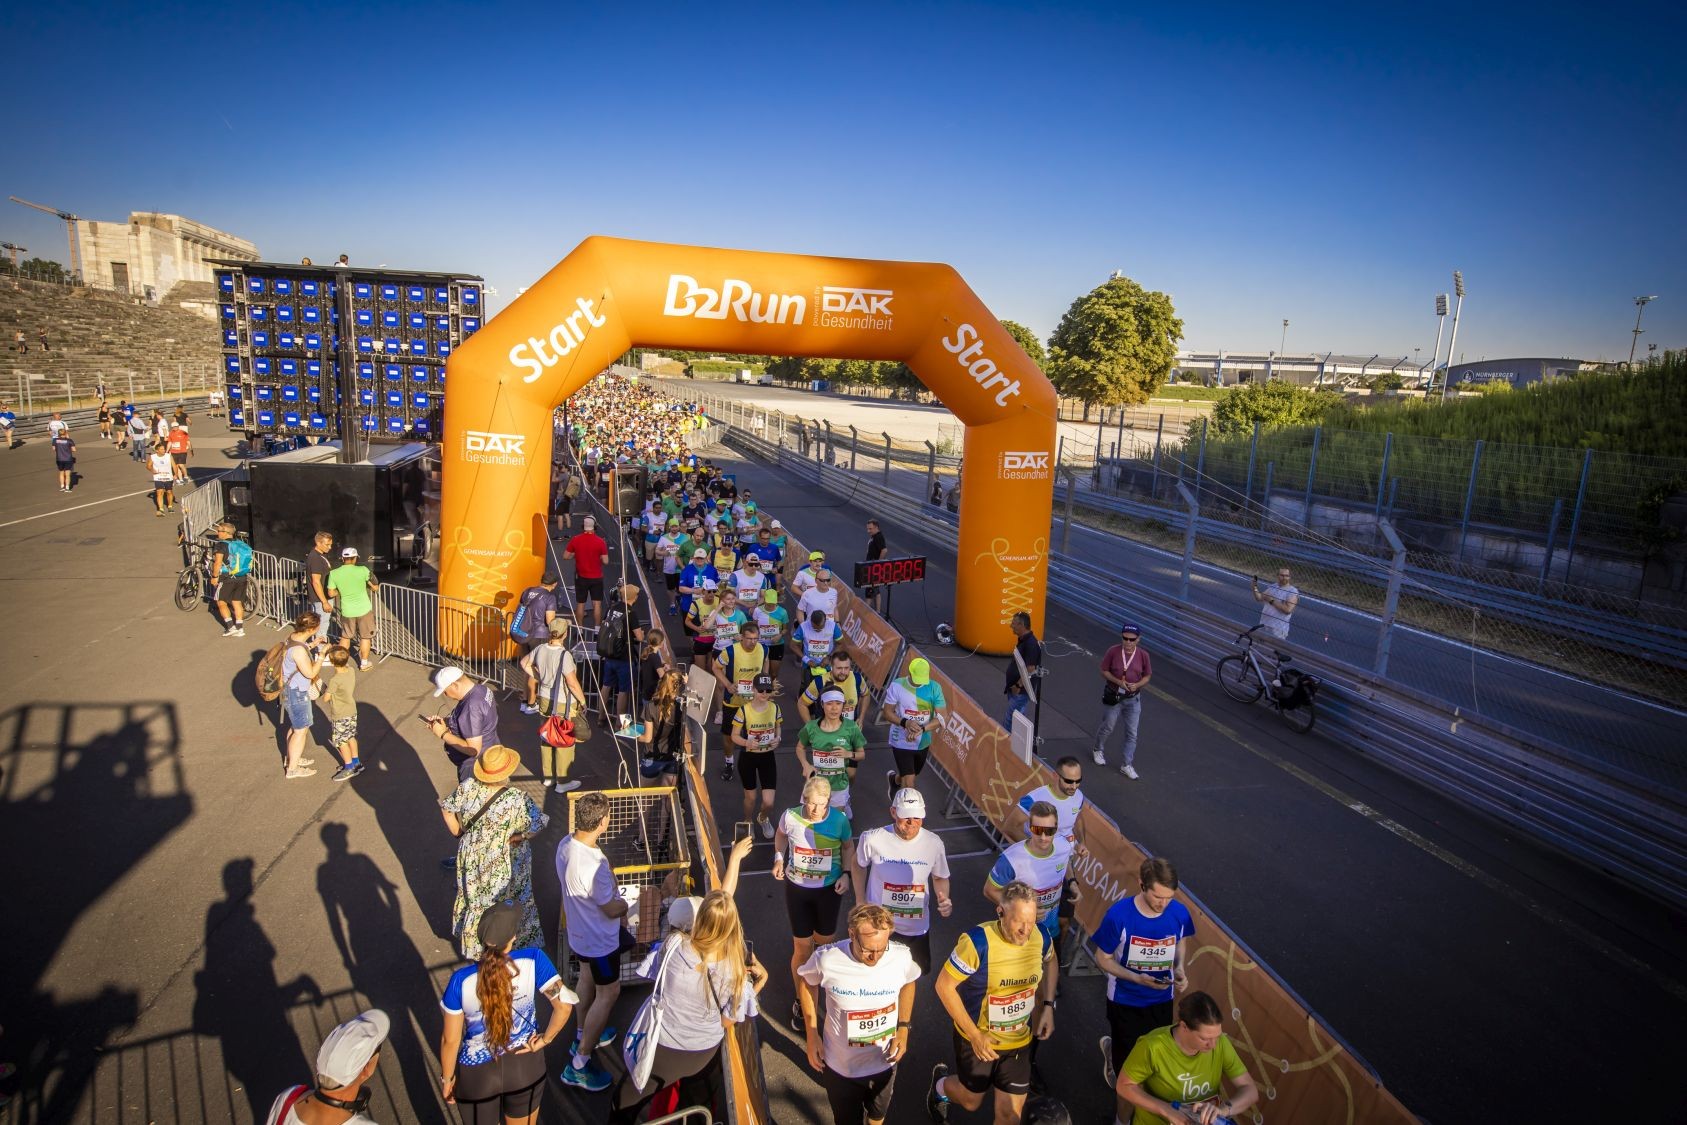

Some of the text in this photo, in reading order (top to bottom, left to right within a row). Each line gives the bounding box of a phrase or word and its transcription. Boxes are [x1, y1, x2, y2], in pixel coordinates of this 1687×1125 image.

[663, 274, 806, 325] B2Run
[822, 286, 894, 316] DAK
[821, 311, 893, 330] Gesundheit
[509, 297, 606, 384] Start
[942, 323, 1021, 407] Start
[466, 430, 525, 455] DAK
[465, 449, 525, 466] Gesundheit
[1003, 451, 1048, 469] DAK
[1003, 468, 1048, 480] Gesundheit
[866, 559, 923, 584] 19:02:05
[945, 711, 976, 752] DAK
[941, 729, 968, 763] Gesuheit
[801, 855, 824, 865] 2357
[891, 892, 916, 902] 8907
[1139, 947, 1167, 956] 4345
[999, 978, 1028, 987] Allianz
[1000, 1001, 1026, 1015] 1883
[859, 1016, 887, 1030] 8912
